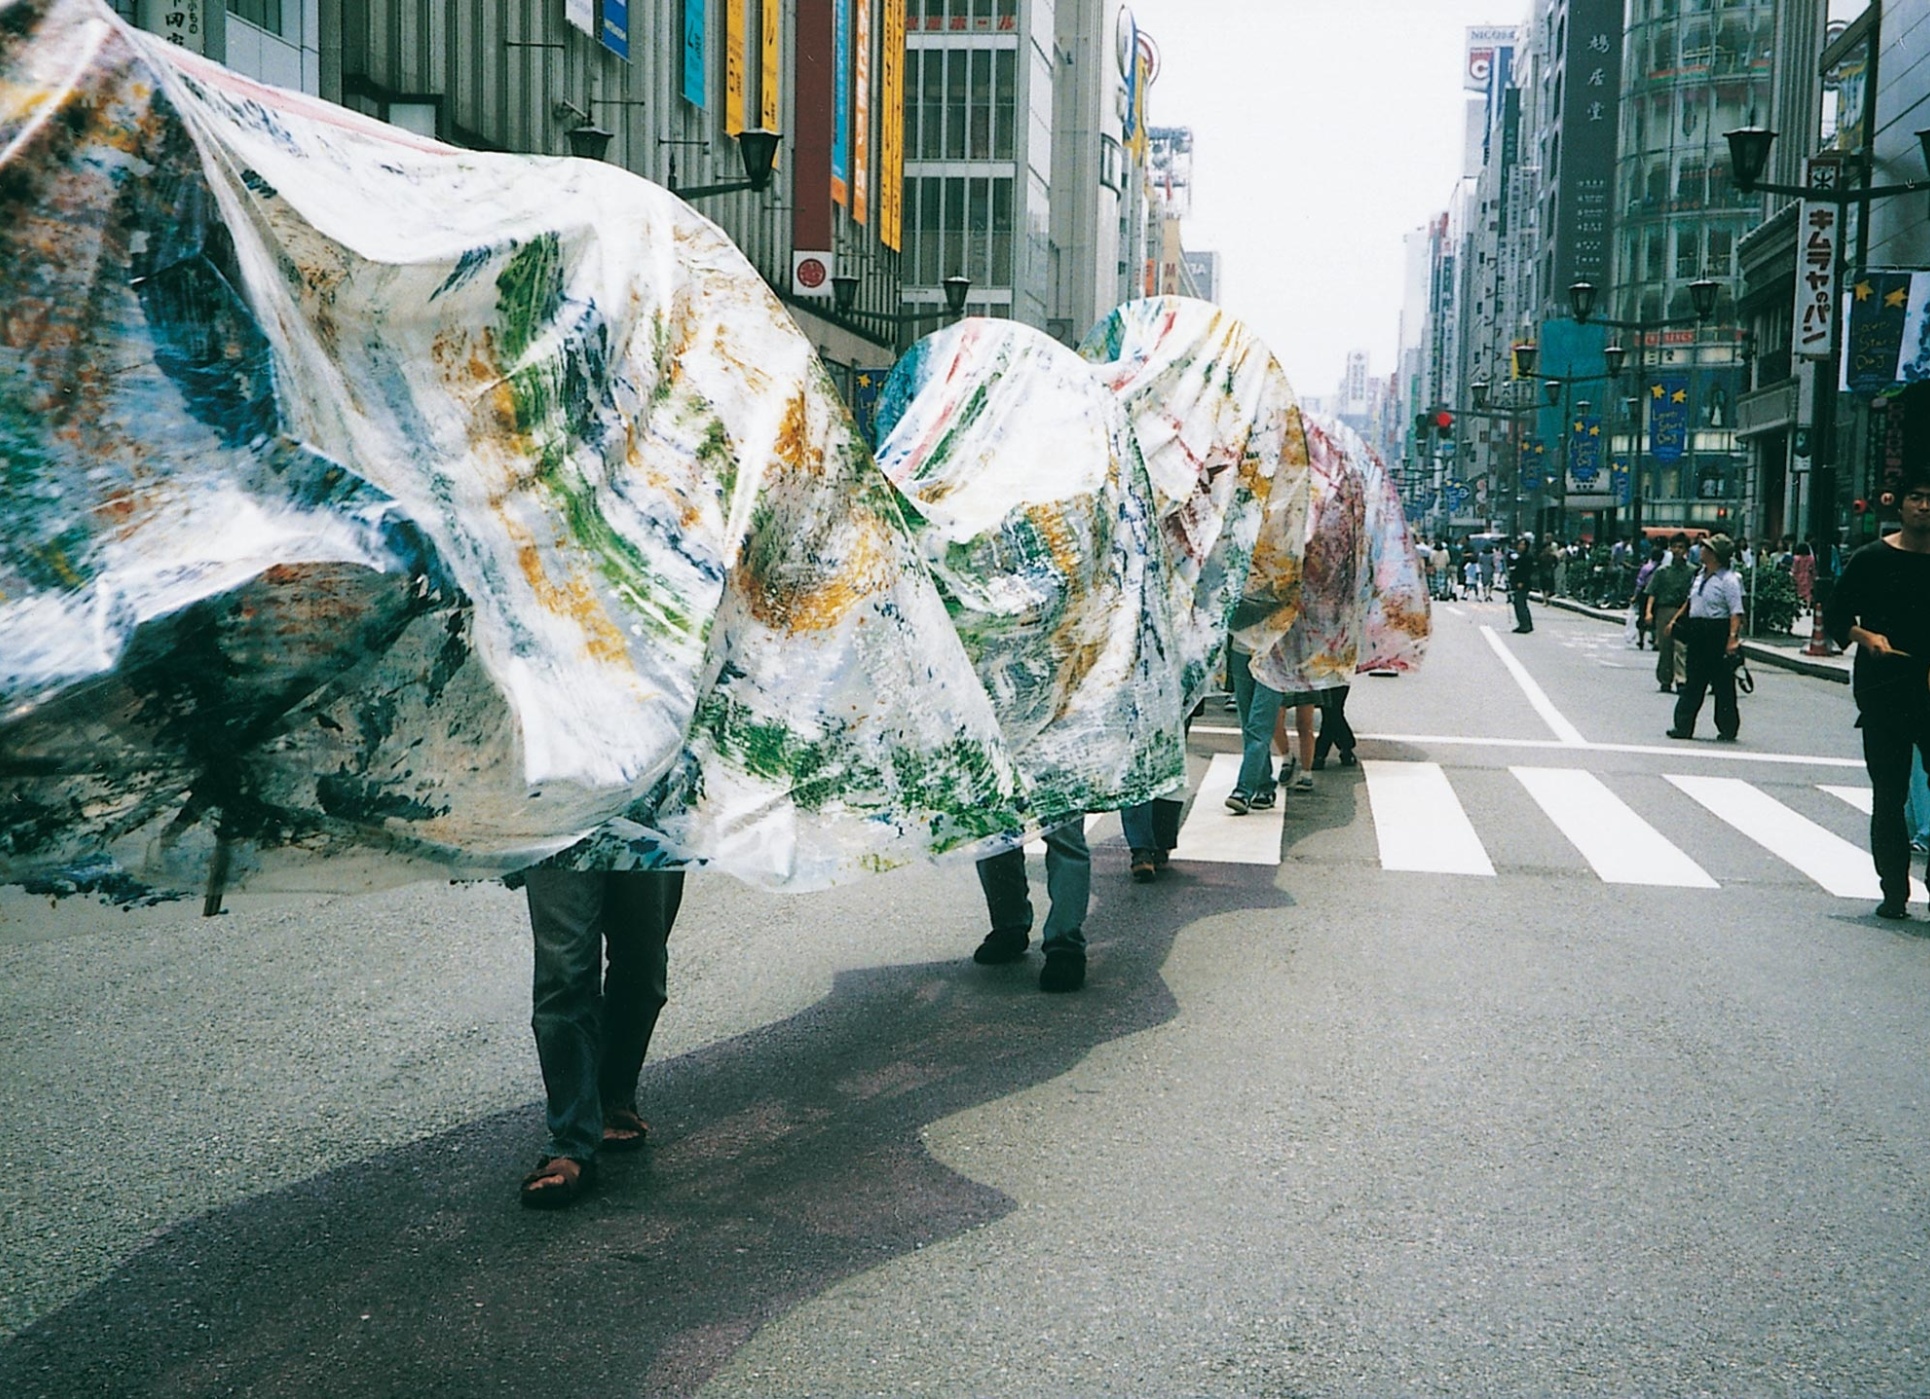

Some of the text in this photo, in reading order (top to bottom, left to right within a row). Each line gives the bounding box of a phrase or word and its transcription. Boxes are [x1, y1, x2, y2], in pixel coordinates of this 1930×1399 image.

[1587, 34, 1610, 121] 鳩居堂
[1802, 209, 1834, 345] キムラヤのパン
